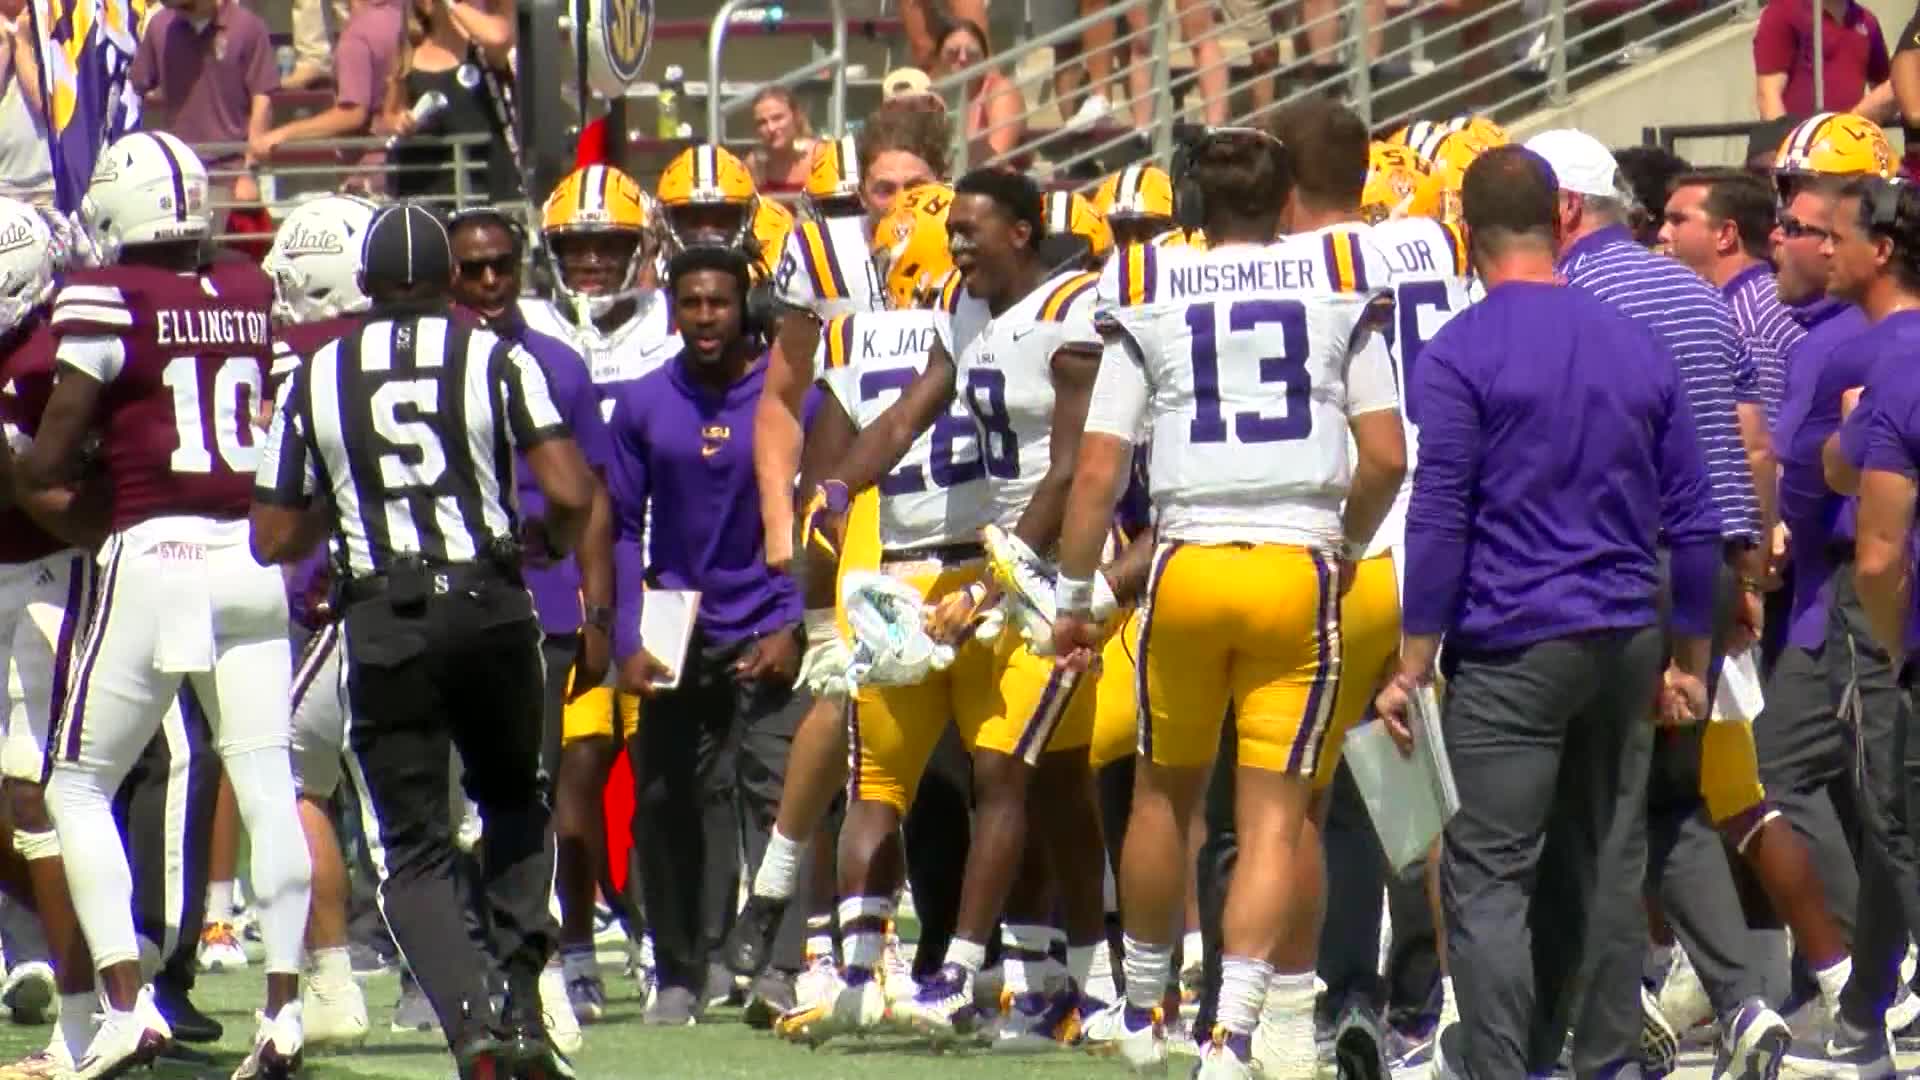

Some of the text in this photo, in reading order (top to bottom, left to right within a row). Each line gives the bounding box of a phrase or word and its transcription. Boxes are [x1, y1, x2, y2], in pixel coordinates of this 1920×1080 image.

[280, 221, 343, 259] State
[1170, 259, 1315, 299] NUSSMEIER
[157, 309, 267, 344] ELLINGTON
[863, 327, 936, 359] K. JAC
[1185, 299, 1313, 444] 13
[162, 356, 267, 472] 10
[370, 378, 447, 488] S
[702, 426, 731, 439] LSU
[159, 543, 204, 561] STATE
